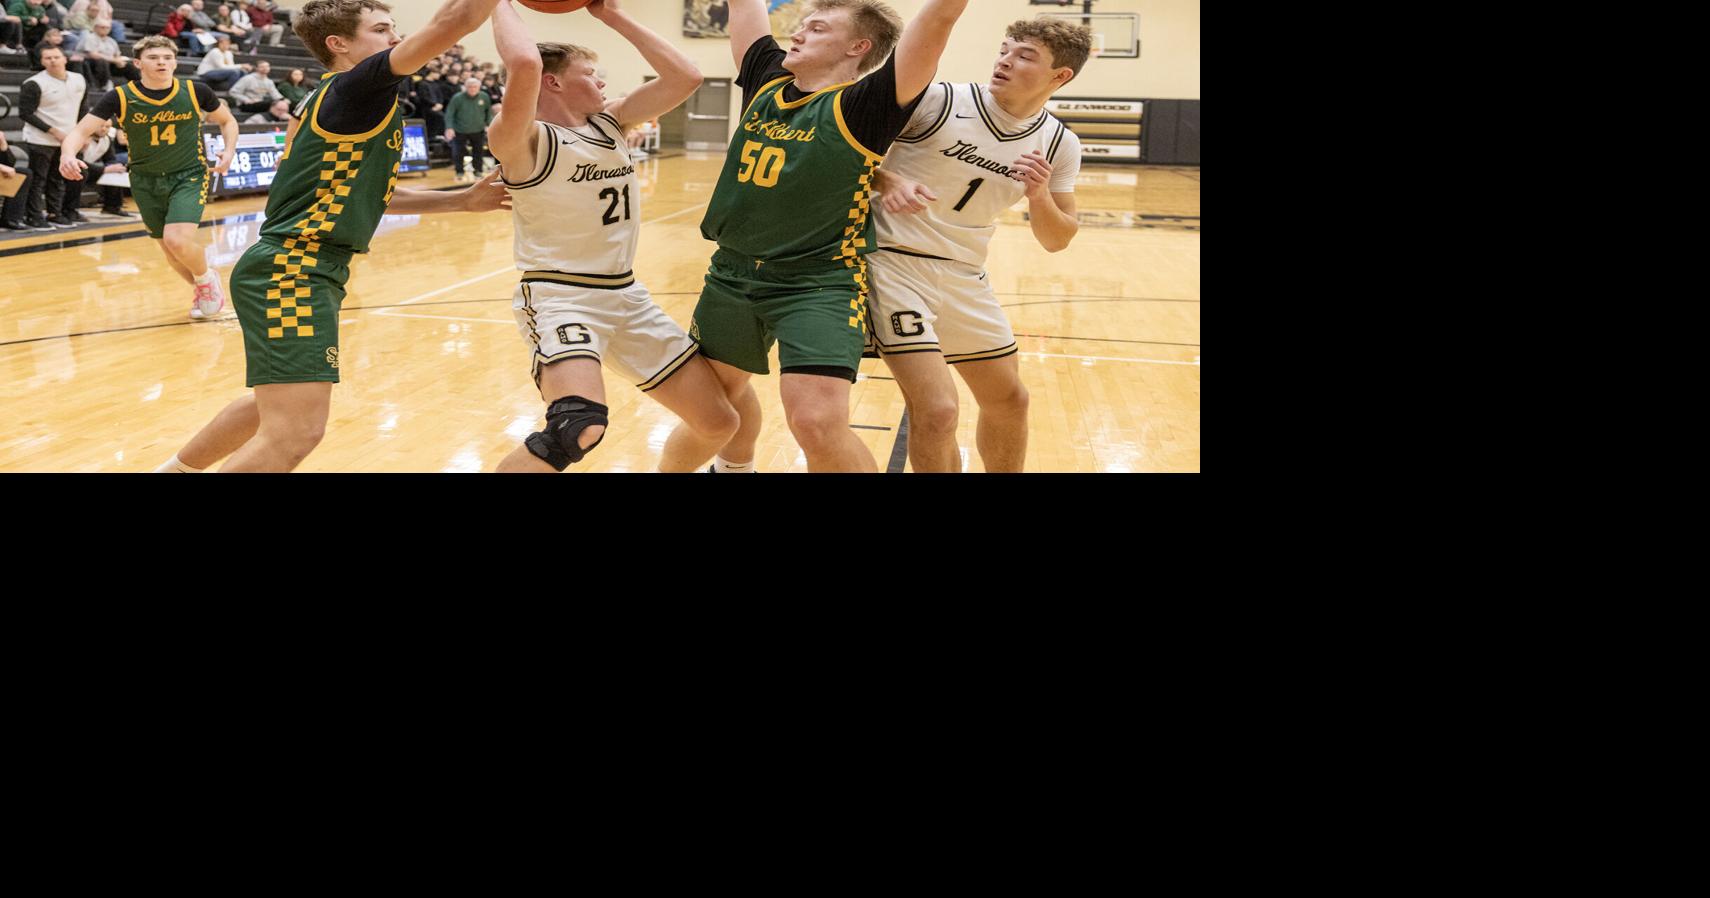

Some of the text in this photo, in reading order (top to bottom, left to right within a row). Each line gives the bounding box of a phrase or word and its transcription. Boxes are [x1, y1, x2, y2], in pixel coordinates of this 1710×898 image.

[132, 110, 193, 123] St Albert
[150, 124, 177, 145] 14
[737, 139, 786, 188] 50
[939, 140, 1023, 182] Glenwoo
[599, 184, 630, 225] 21
[952, 177, 985, 212] 1
[556, 322, 591, 345] G
[890, 310, 925, 337] G
